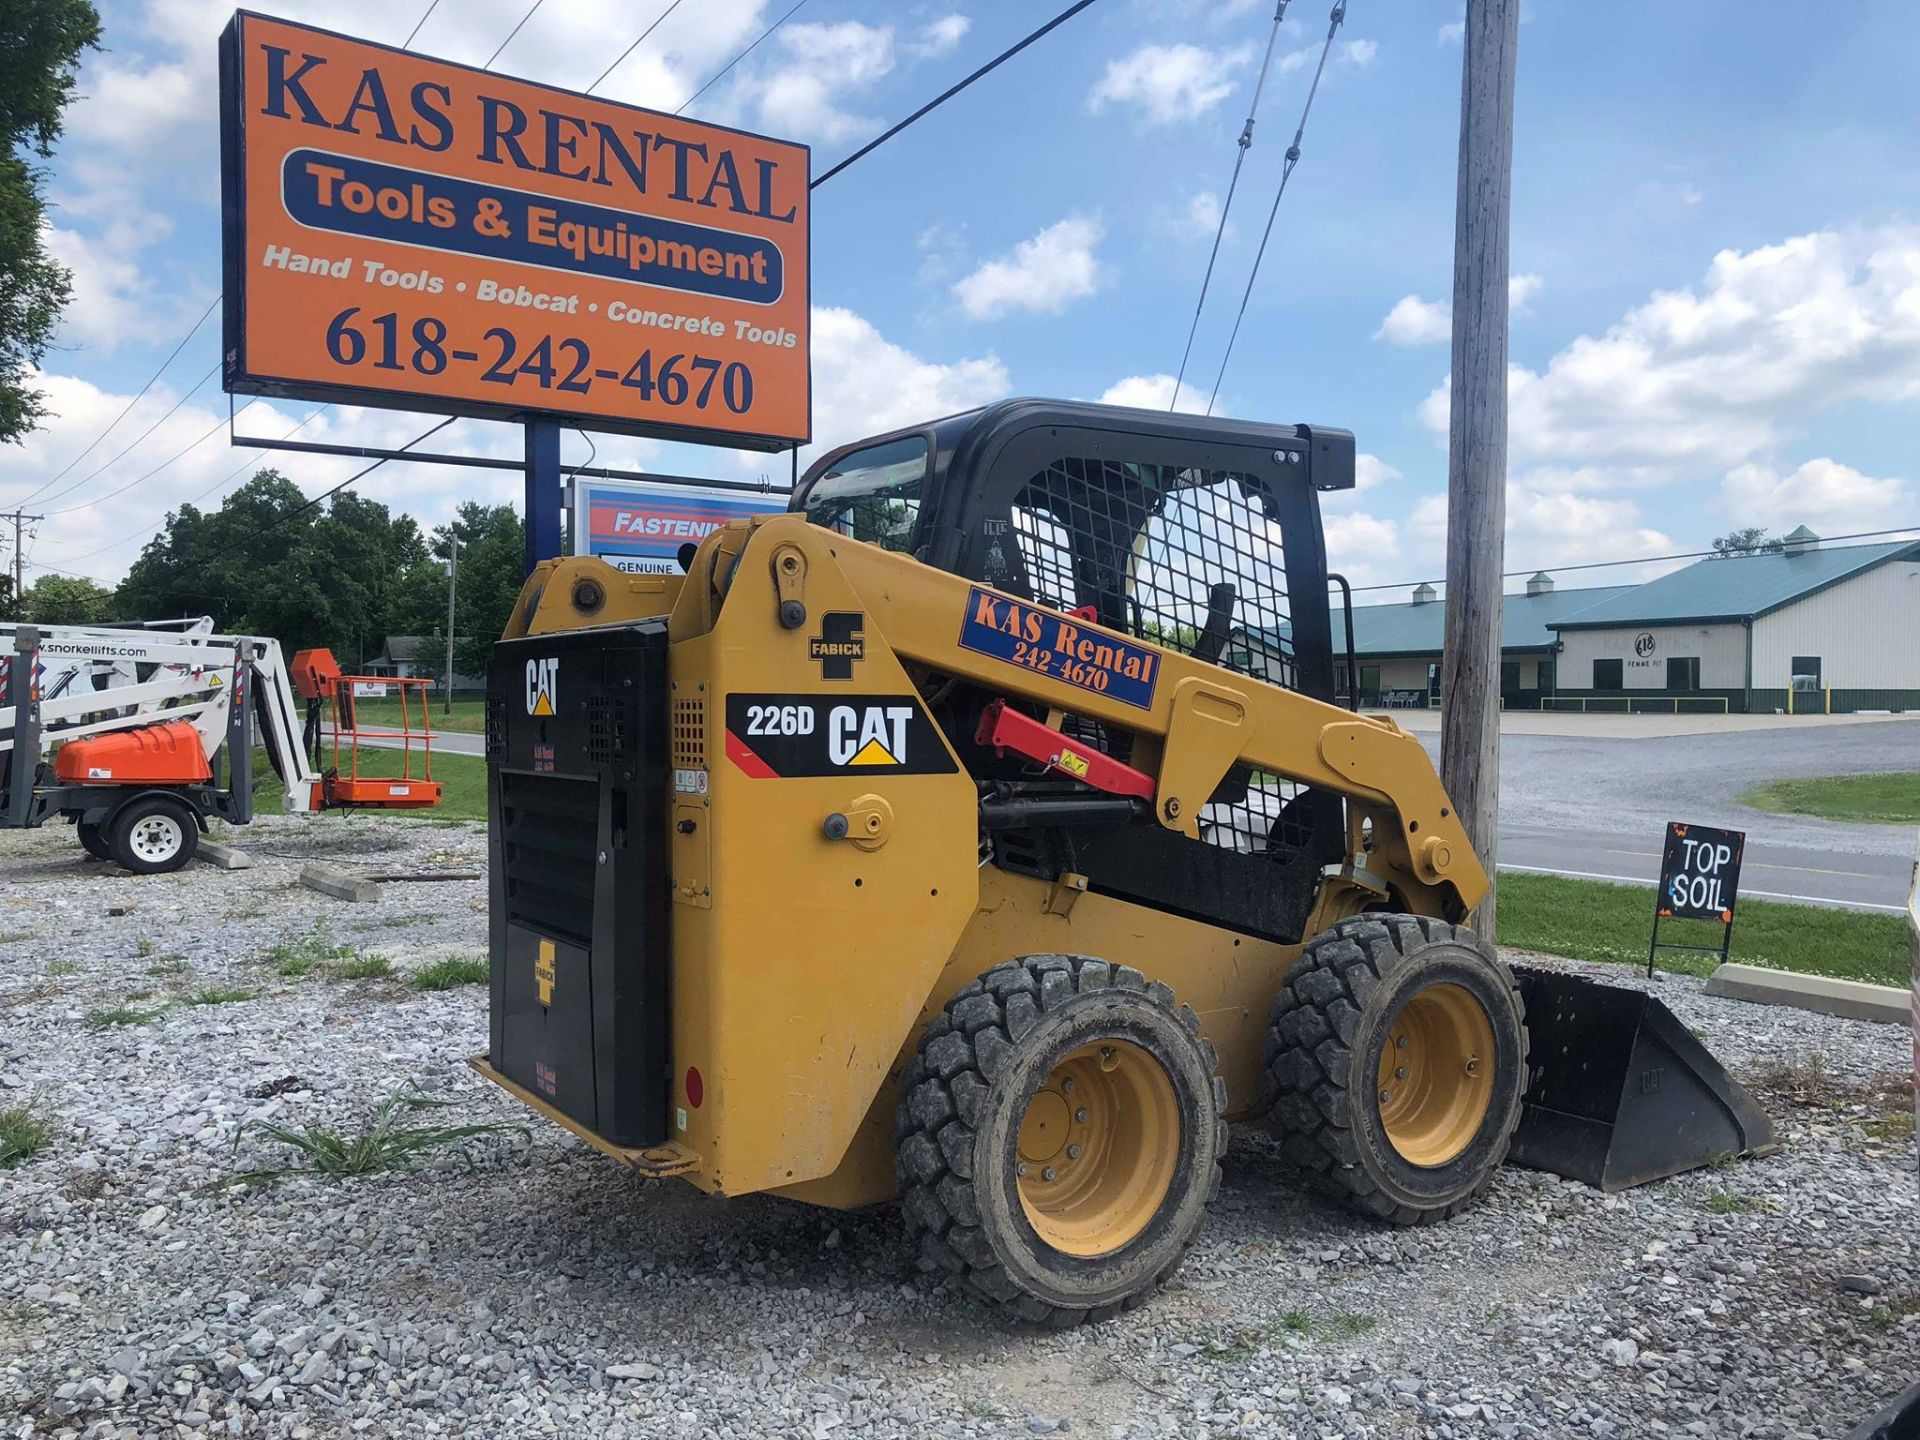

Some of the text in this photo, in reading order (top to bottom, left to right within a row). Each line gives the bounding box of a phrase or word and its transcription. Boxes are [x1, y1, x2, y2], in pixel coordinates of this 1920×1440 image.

[260, 43, 797, 224] KAS RENTAL
[305, 162, 768, 285] Tools & Equipment
[262, 244, 798, 349] Hand Tools Bobcat Concrete Tools
[326, 306, 754, 415] 618-242-4670
[617, 561, 674, 575] GENUINE
[811, 642, 863, 657] FABICK
[974, 593, 1153, 684] KAS Rental
[1011, 641, 1109, 692] 242-4670
[526, 658, 559, 716] CAT
[746, 705, 913, 766] 226D CAT
[1683, 839, 1731, 875] TOP
[1672, 873, 1728, 912] SOIL
